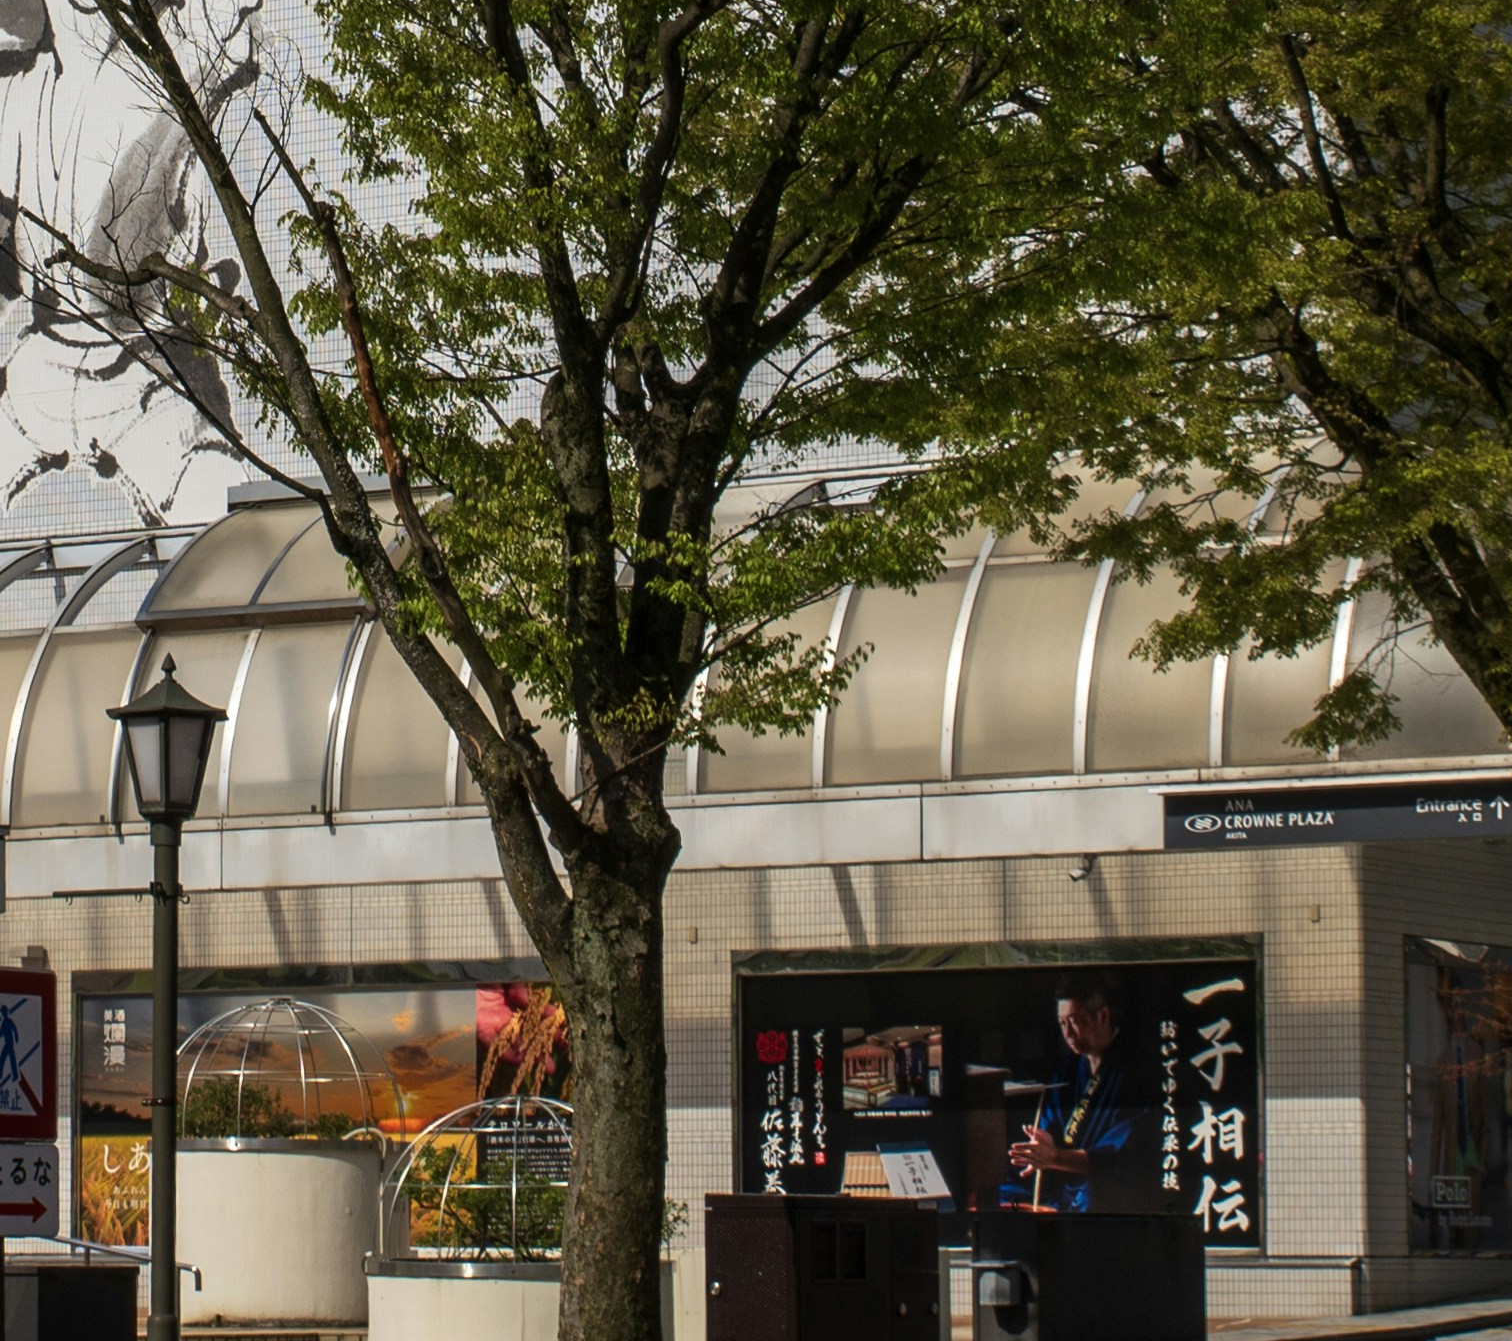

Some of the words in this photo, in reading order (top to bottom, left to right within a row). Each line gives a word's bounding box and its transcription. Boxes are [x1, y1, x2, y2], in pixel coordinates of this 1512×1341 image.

[1225, 799, 1255, 812] ANA
[1416, 798, 1483, 814] Entrance
[1225, 811, 1285, 829] CROWNE
[1288, 811, 1334, 827] PLAZA
[1456, 813, 1483, 823] 入口
[1181, 976, 1251, 1235] 一子相伝
[1435, 1181, 1468, 1202] Polo
